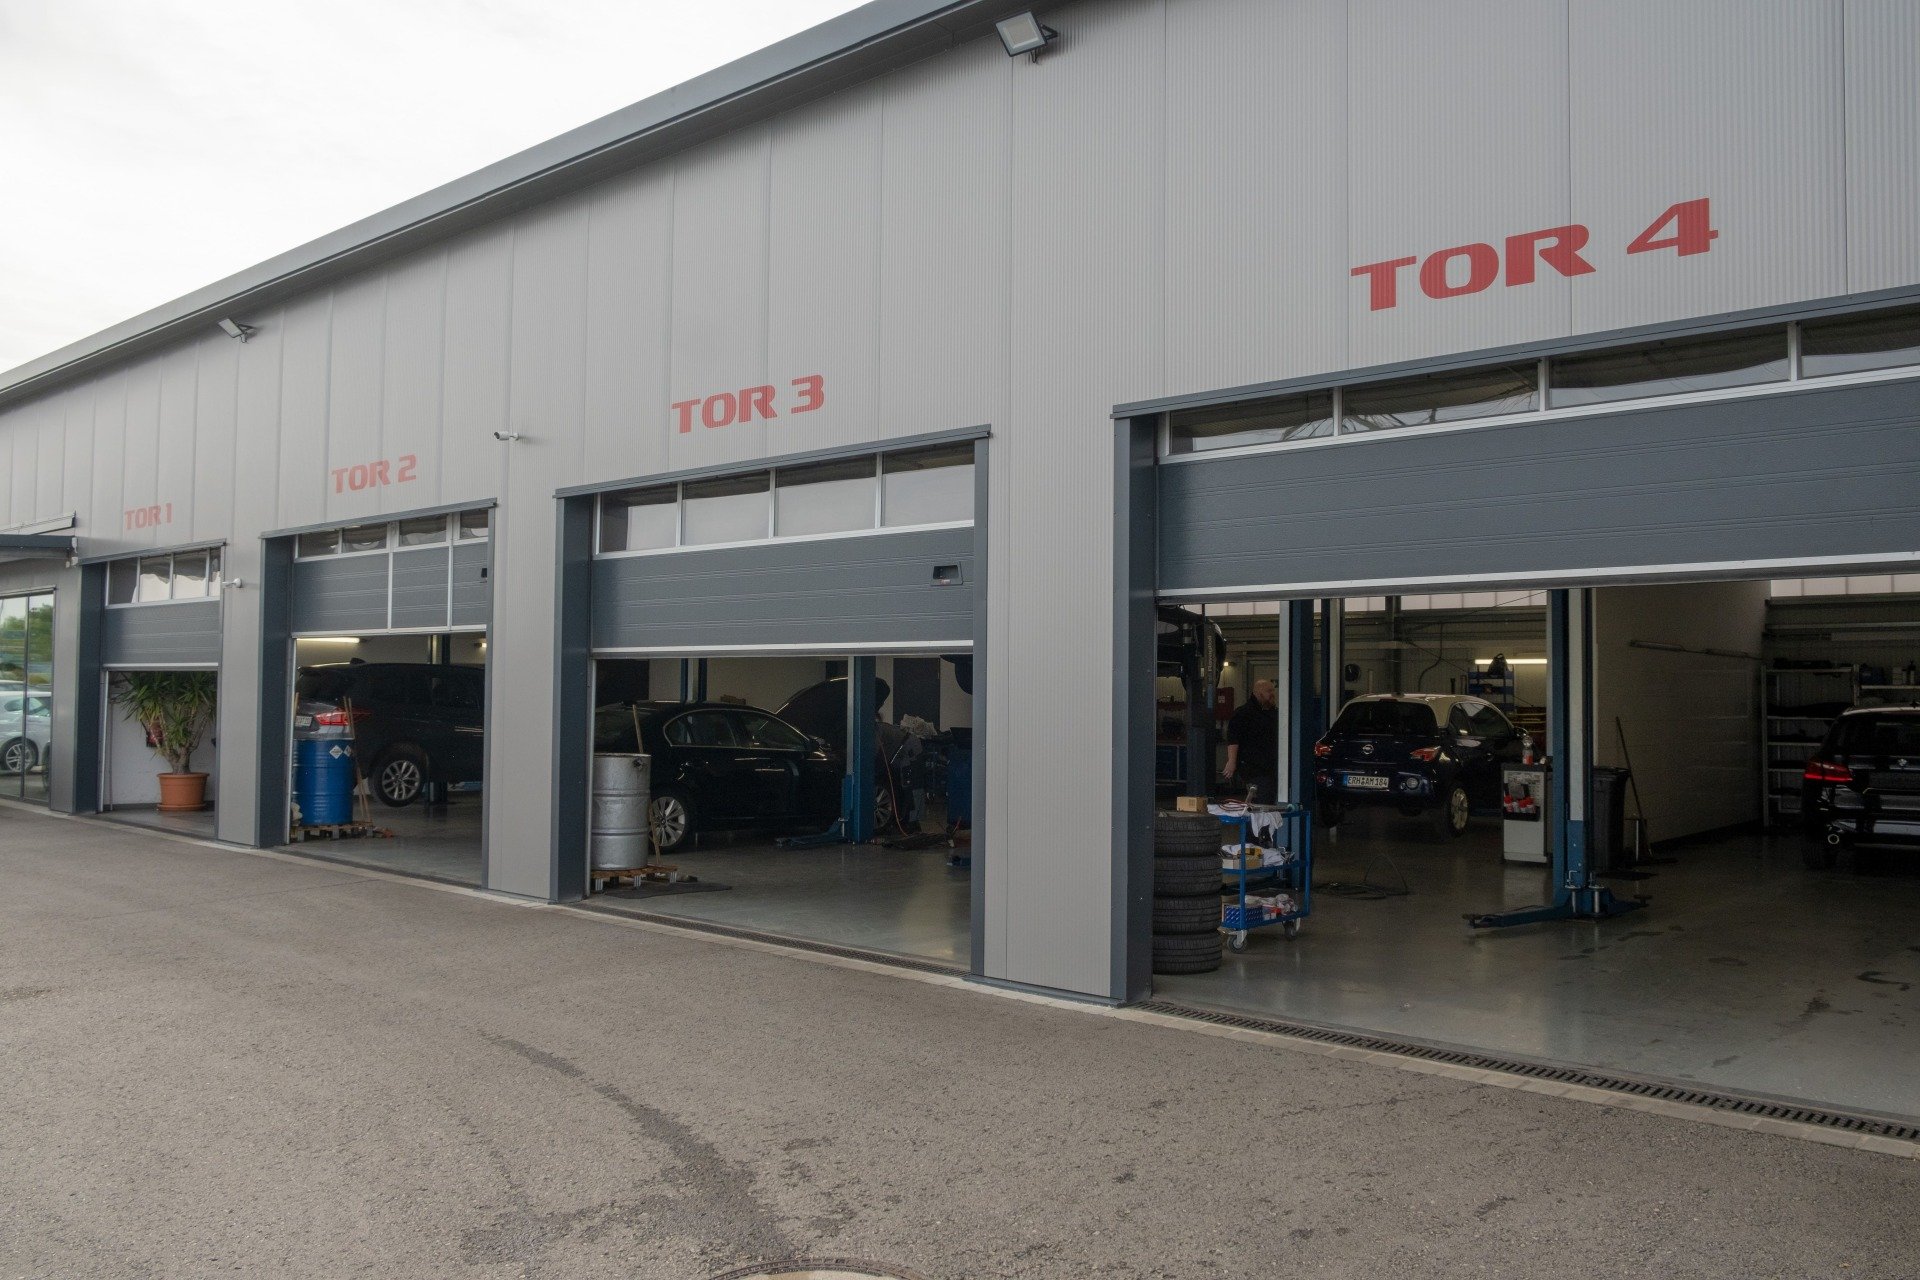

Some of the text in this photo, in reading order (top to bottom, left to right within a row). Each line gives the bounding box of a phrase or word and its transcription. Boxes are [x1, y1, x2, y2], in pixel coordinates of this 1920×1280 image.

[1351, 197, 1719, 311] TOR 4
[672, 375, 825, 434] TOR 3
[332, 455, 418, 493] TOR 2
[124, 502, 172, 530] TOR 1
